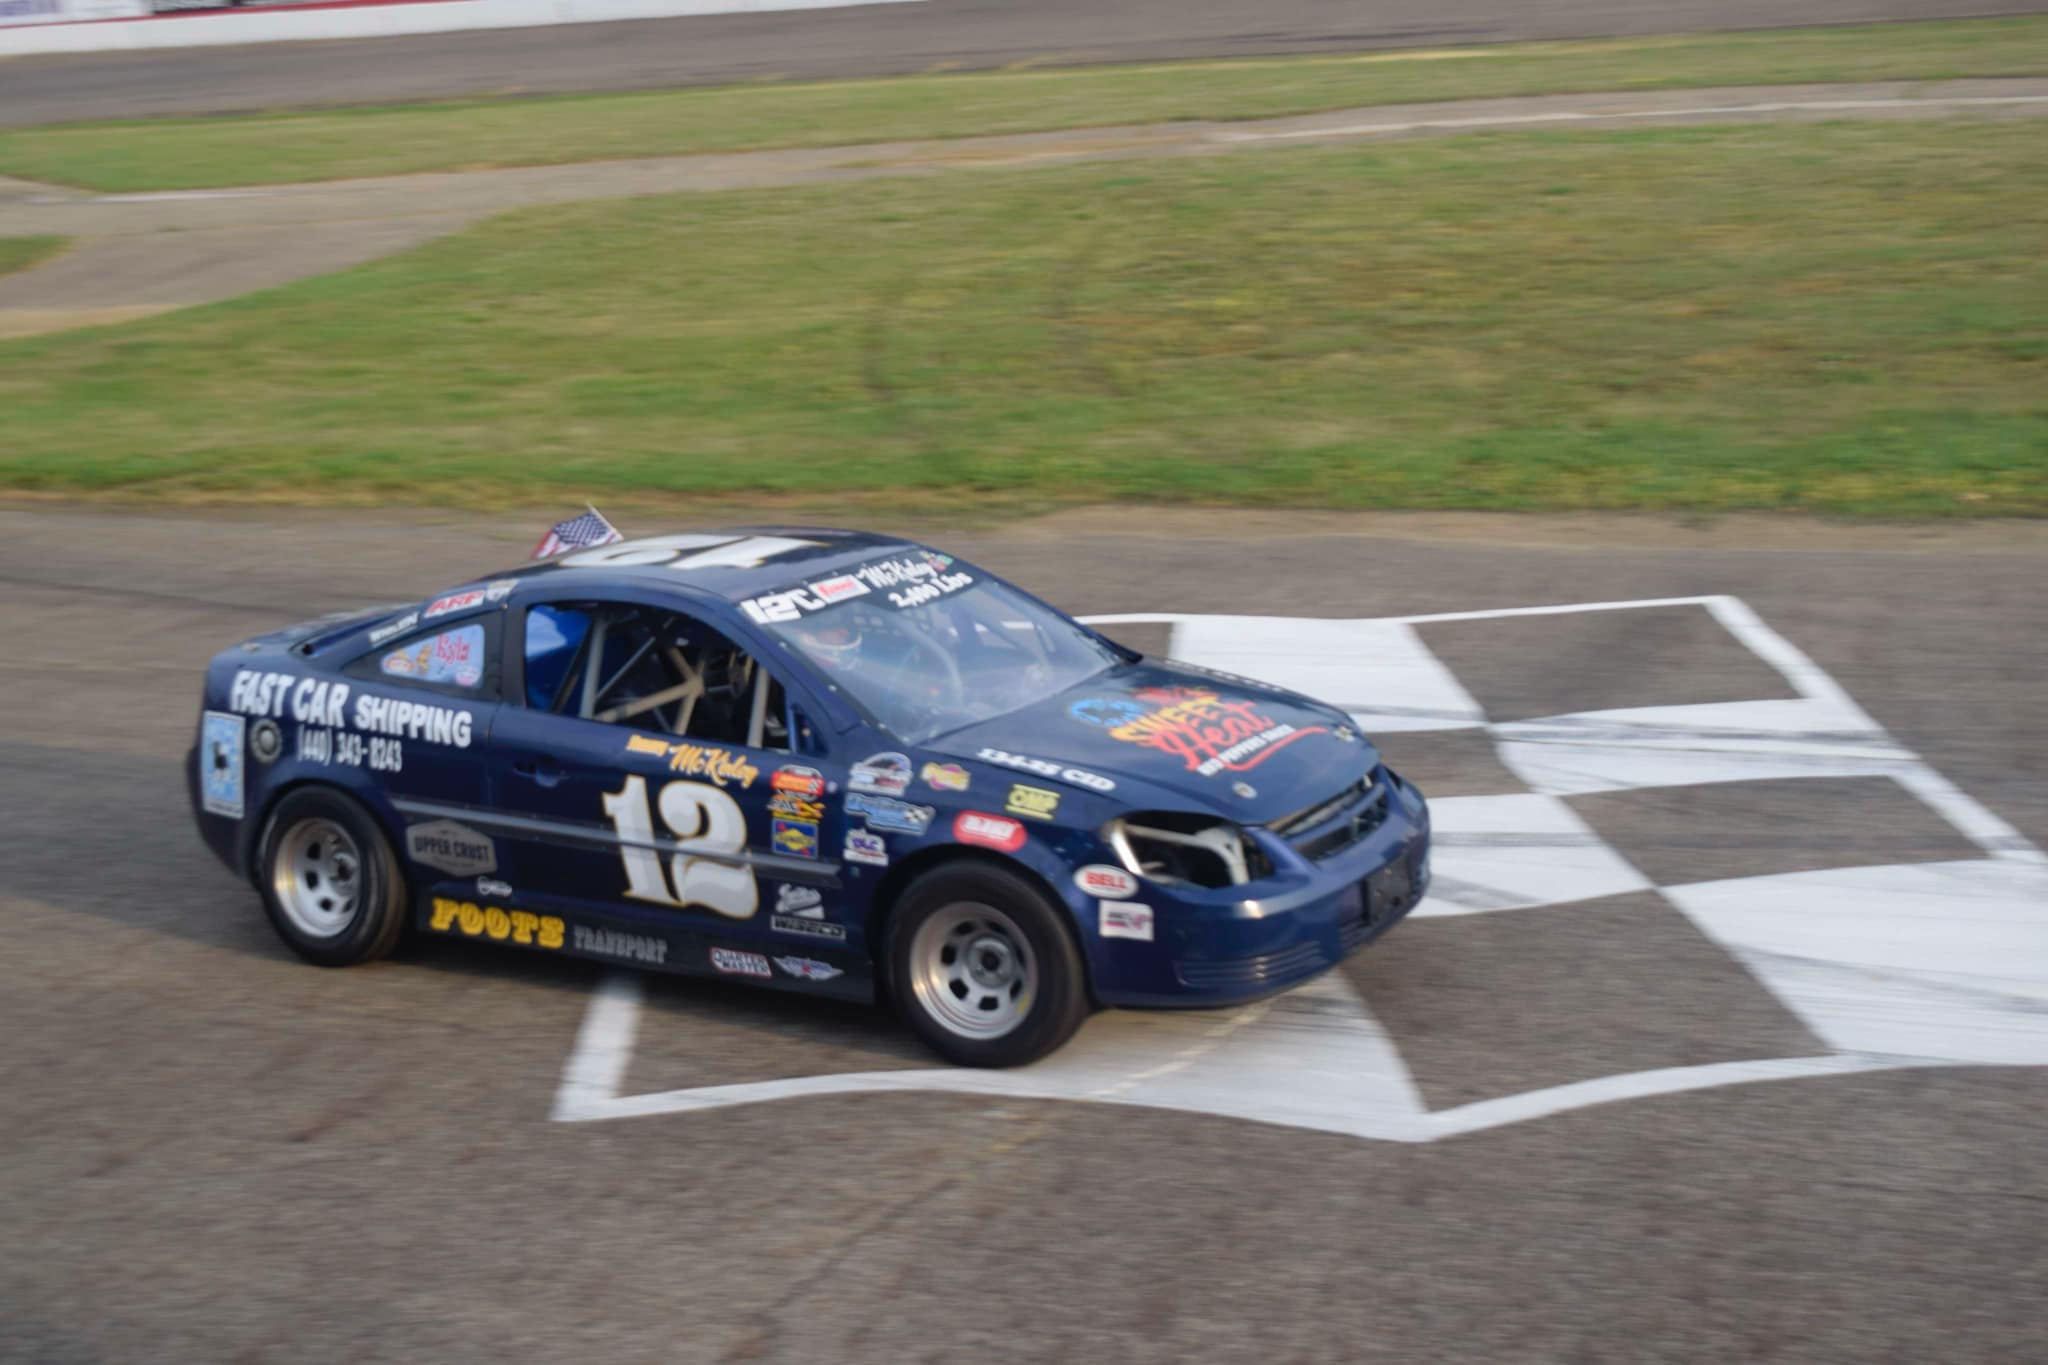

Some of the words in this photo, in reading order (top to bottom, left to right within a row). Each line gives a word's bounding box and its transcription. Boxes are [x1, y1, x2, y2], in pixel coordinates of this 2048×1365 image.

[230, 669, 295, 718] FAST
[292, 677, 350, 728] CAR
[354, 694, 473, 747] SHIPPING
[1109, 696, 1226, 743] SWEET
[1152, 700, 1276, 772] Heat
[414, 834, 453, 857] UPPER
[453, 840, 489, 864] CRUST
[602, 774, 760, 920] 12
[1086, 872, 1127, 889] BELL
[430, 897, 566, 950] FOOTS
[573, 925, 668, 964] TRANSPORT
